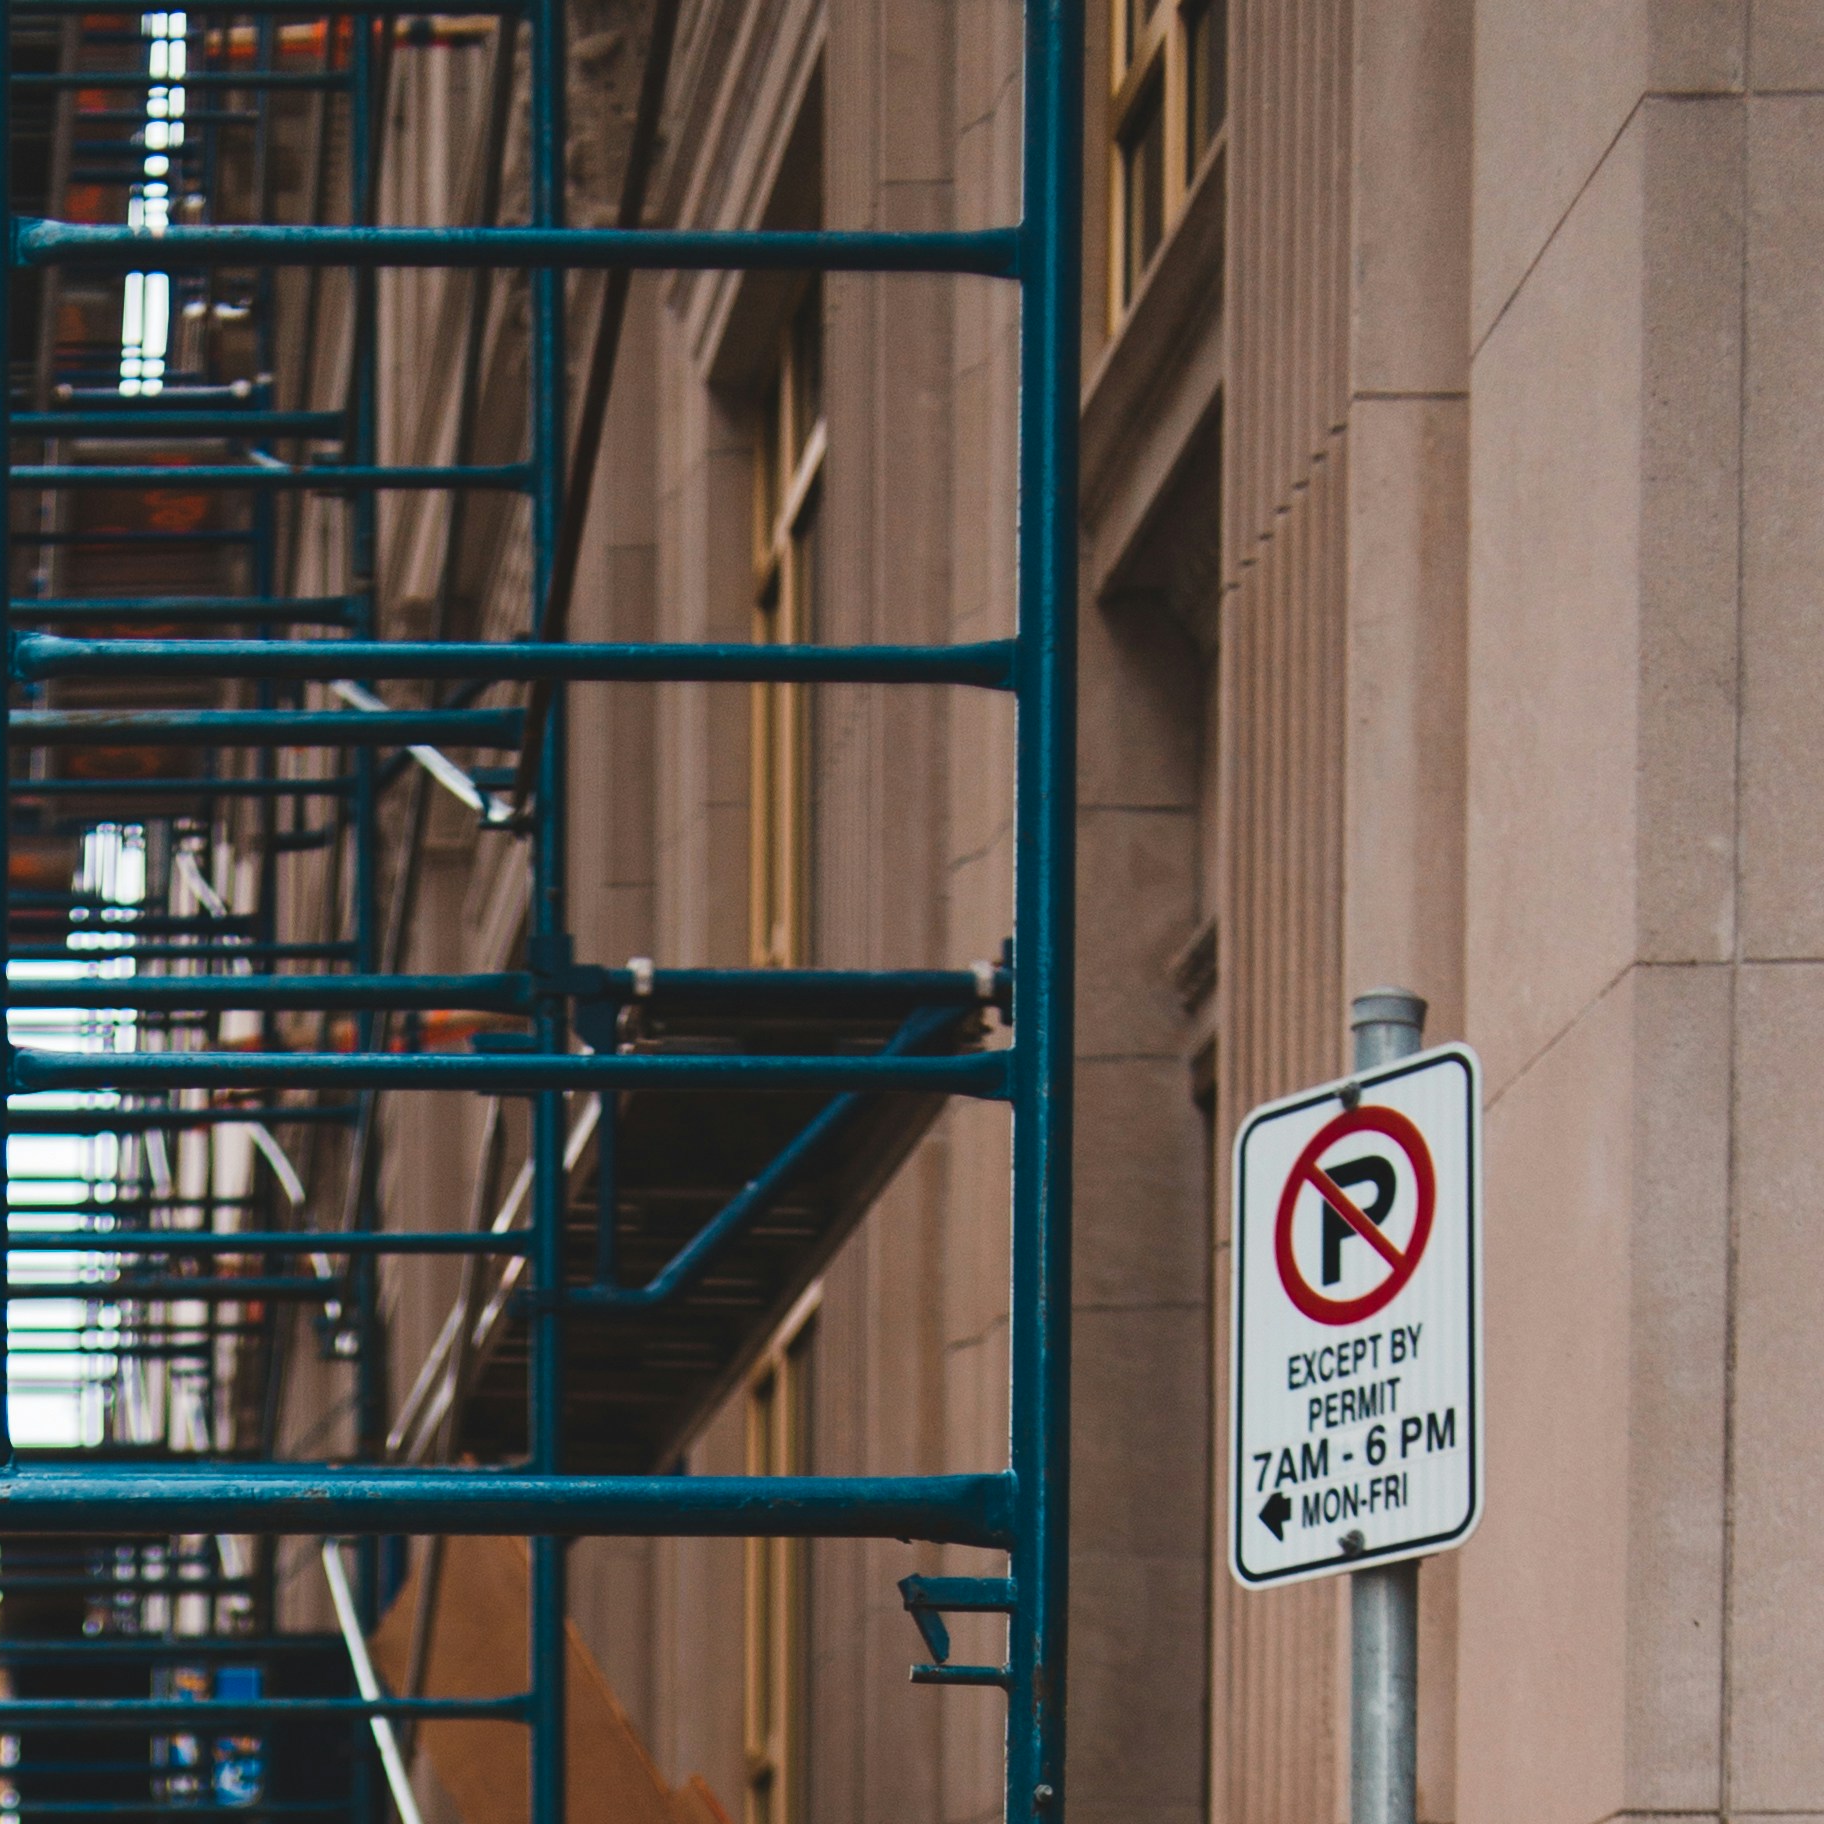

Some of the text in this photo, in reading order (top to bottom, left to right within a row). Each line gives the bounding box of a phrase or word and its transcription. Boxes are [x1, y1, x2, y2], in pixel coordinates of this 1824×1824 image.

[1288, 1322, 1423, 1391] EXCEPT BY
[1308, 1376, 1401, 1432] PERMIT
[1253, 1438, 1328, 1492] 7AM
[1366, 1424, 1387, 1466] 6
[1401, 1407, 1455, 1459] PM
[1302, 1471, 1408, 1529] MON-FRI
